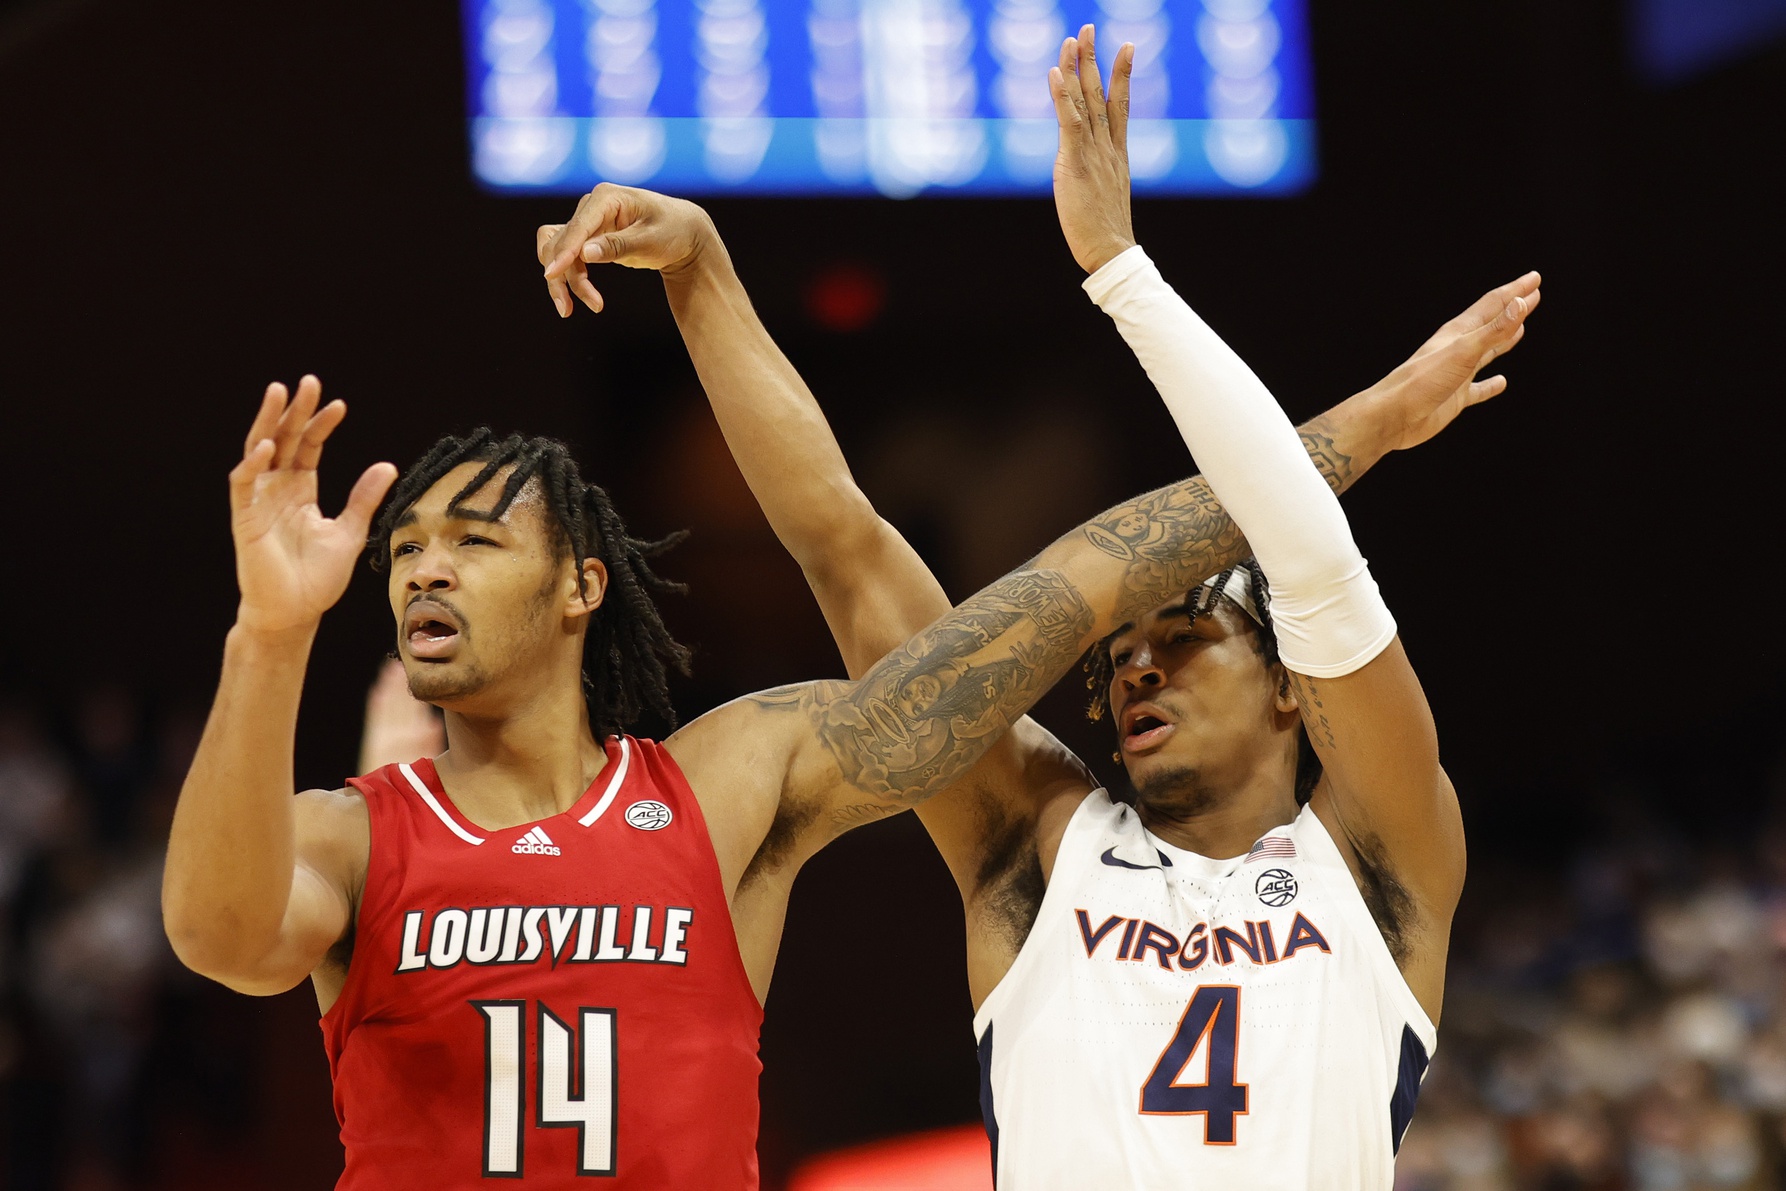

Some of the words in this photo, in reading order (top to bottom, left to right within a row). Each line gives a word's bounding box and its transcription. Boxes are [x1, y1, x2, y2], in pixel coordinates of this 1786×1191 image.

[1176, 480, 1222, 513] CHIL
[633, 809, 666, 819] ACC
[511, 842, 561, 856] adidas
[1261, 878, 1294, 892] ACC
[393, 905, 694, 975] LOUISVILLE
[1074, 908, 1332, 972] VIRGNIA
[468, 999, 617, 1179] 14
[1138, 984, 1249, 1146] 4
